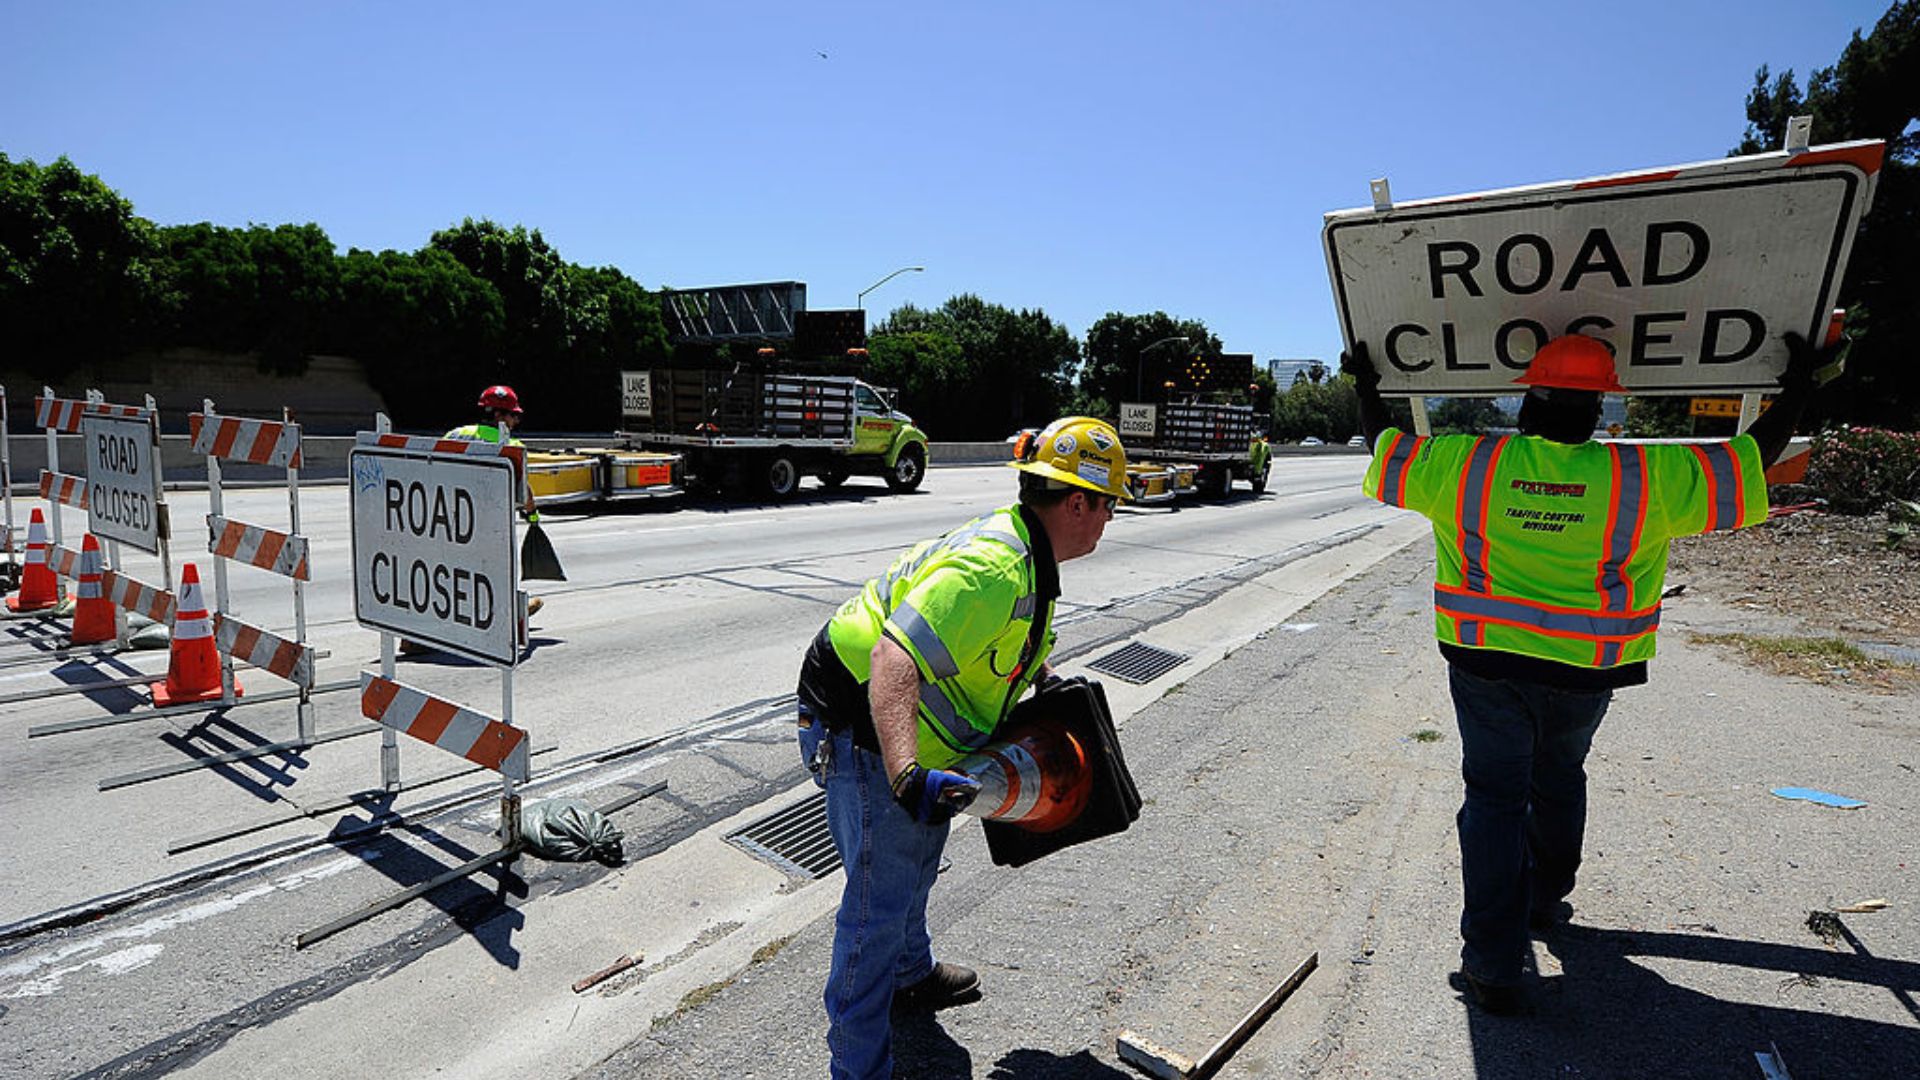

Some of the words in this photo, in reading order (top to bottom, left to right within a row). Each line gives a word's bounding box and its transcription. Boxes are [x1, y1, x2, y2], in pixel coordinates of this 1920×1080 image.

[1426, 220, 1710, 299] ROAD
[626, 378, 646, 393] LANE
[623, 395, 650, 410] CLOSED
[1128, 408, 1149, 419] LANE
[1122, 420, 1154, 432] CLOSED
[98, 434, 138, 475] ROAD
[93, 483, 149, 531] CLOSED
[386, 479, 475, 544] ROAD
[1506, 508, 1542, 519] TRAFFIC
[1543, 512, 1585, 522] CONTROL
[1522, 521, 1565, 533] DIVISION
[371, 552, 494, 630] CLOSED
